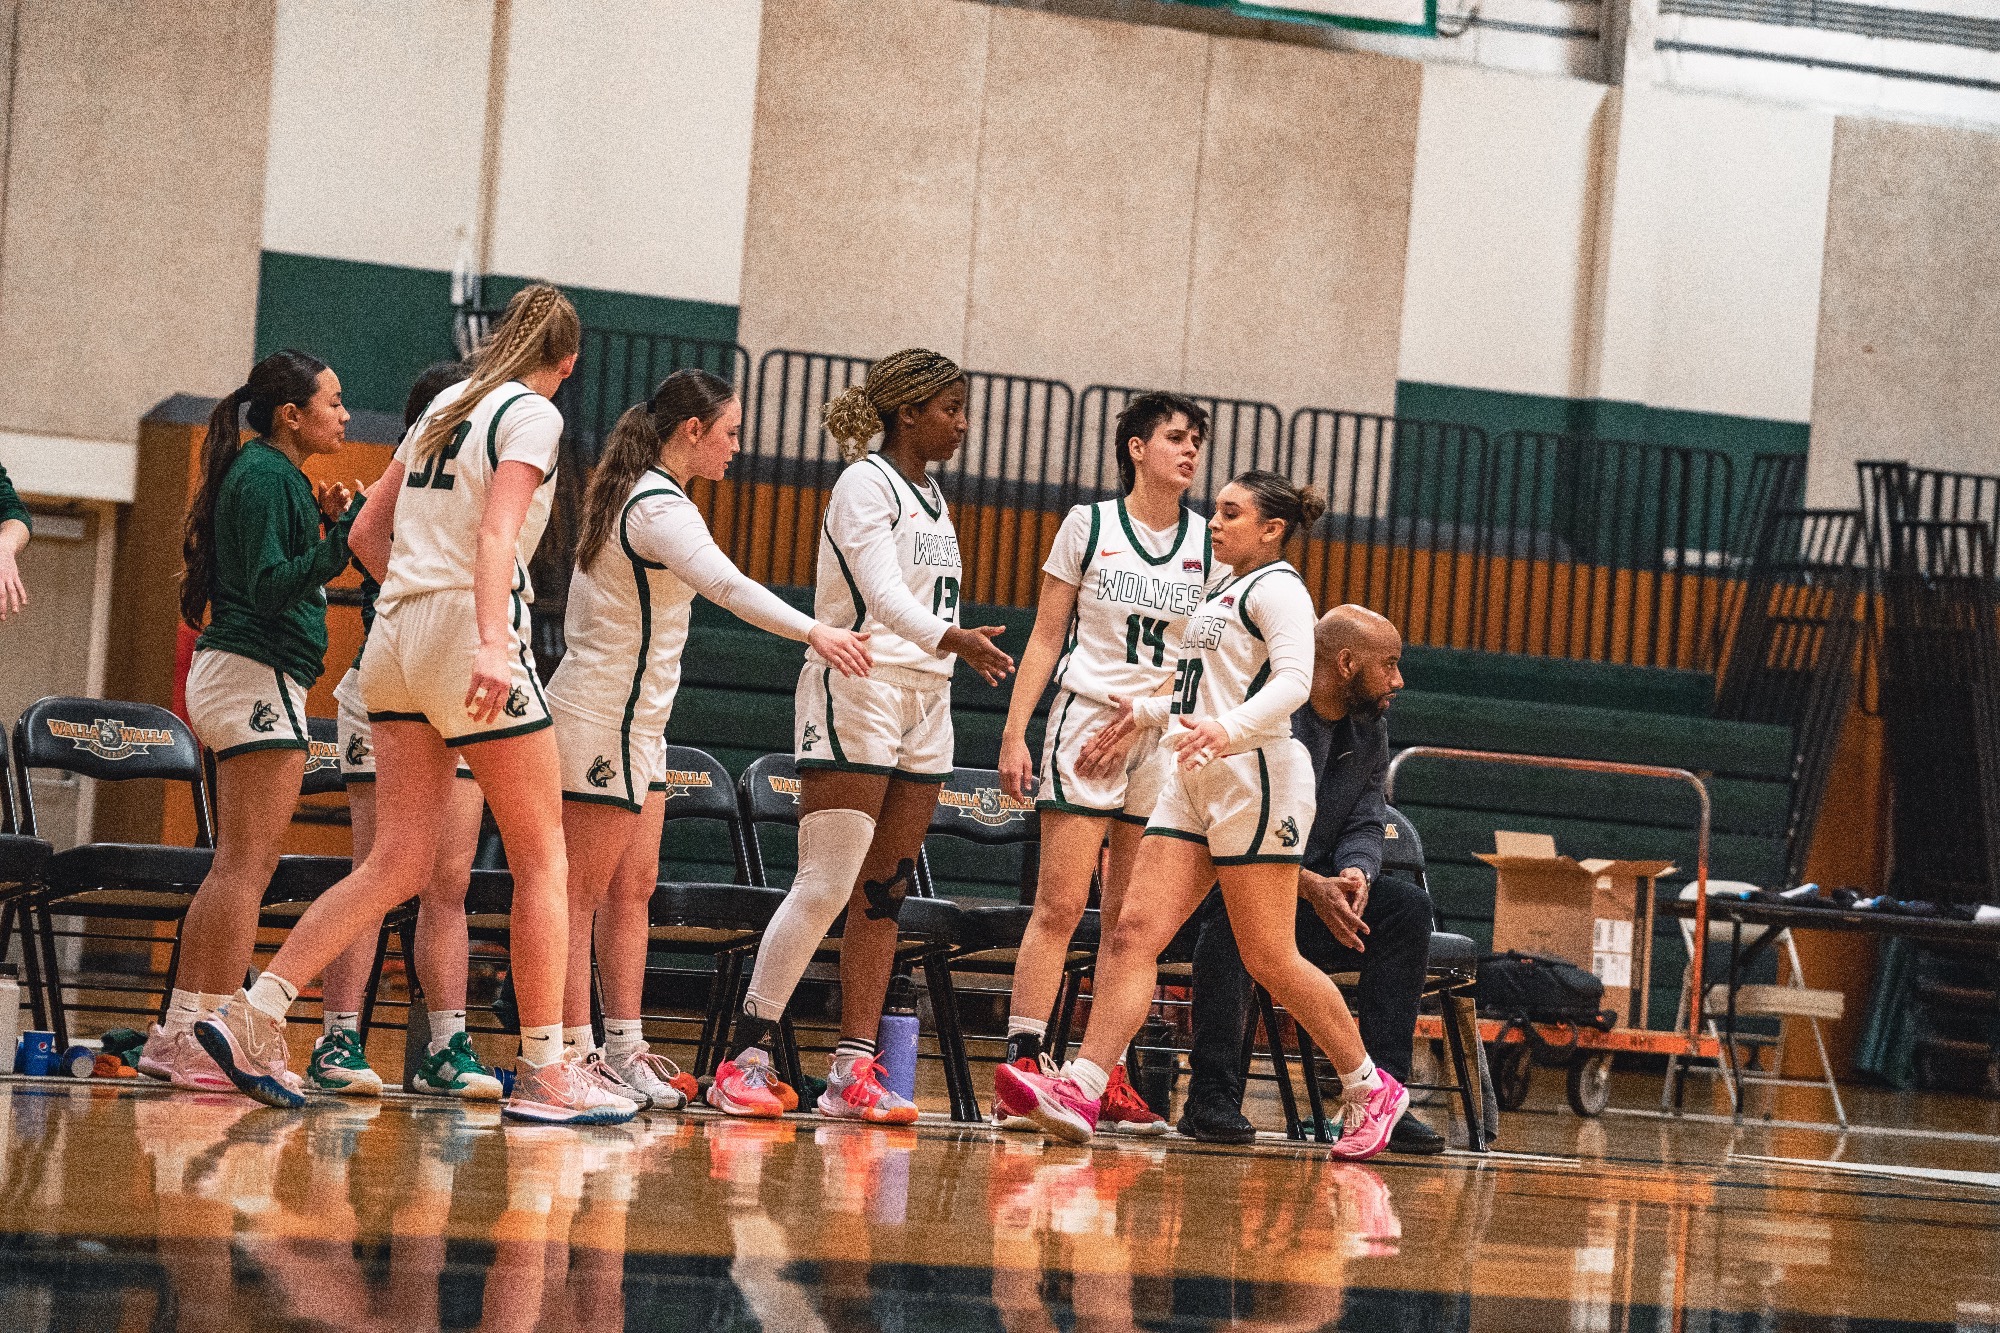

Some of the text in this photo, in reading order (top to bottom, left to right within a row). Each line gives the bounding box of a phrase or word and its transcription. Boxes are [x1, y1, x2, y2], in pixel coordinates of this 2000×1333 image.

[933, 576, 960, 623] 13
[1097, 568, 1203, 616] WOLVES
[1126, 613, 1169, 668] 14
[1170, 658, 1203, 714] 20
[47, 719, 174, 745] WALLA WALLA
[308, 741, 340, 758] WAL
[768, 776, 801, 794] WAL
[939, 790, 1036, 811] WALLA WALL
